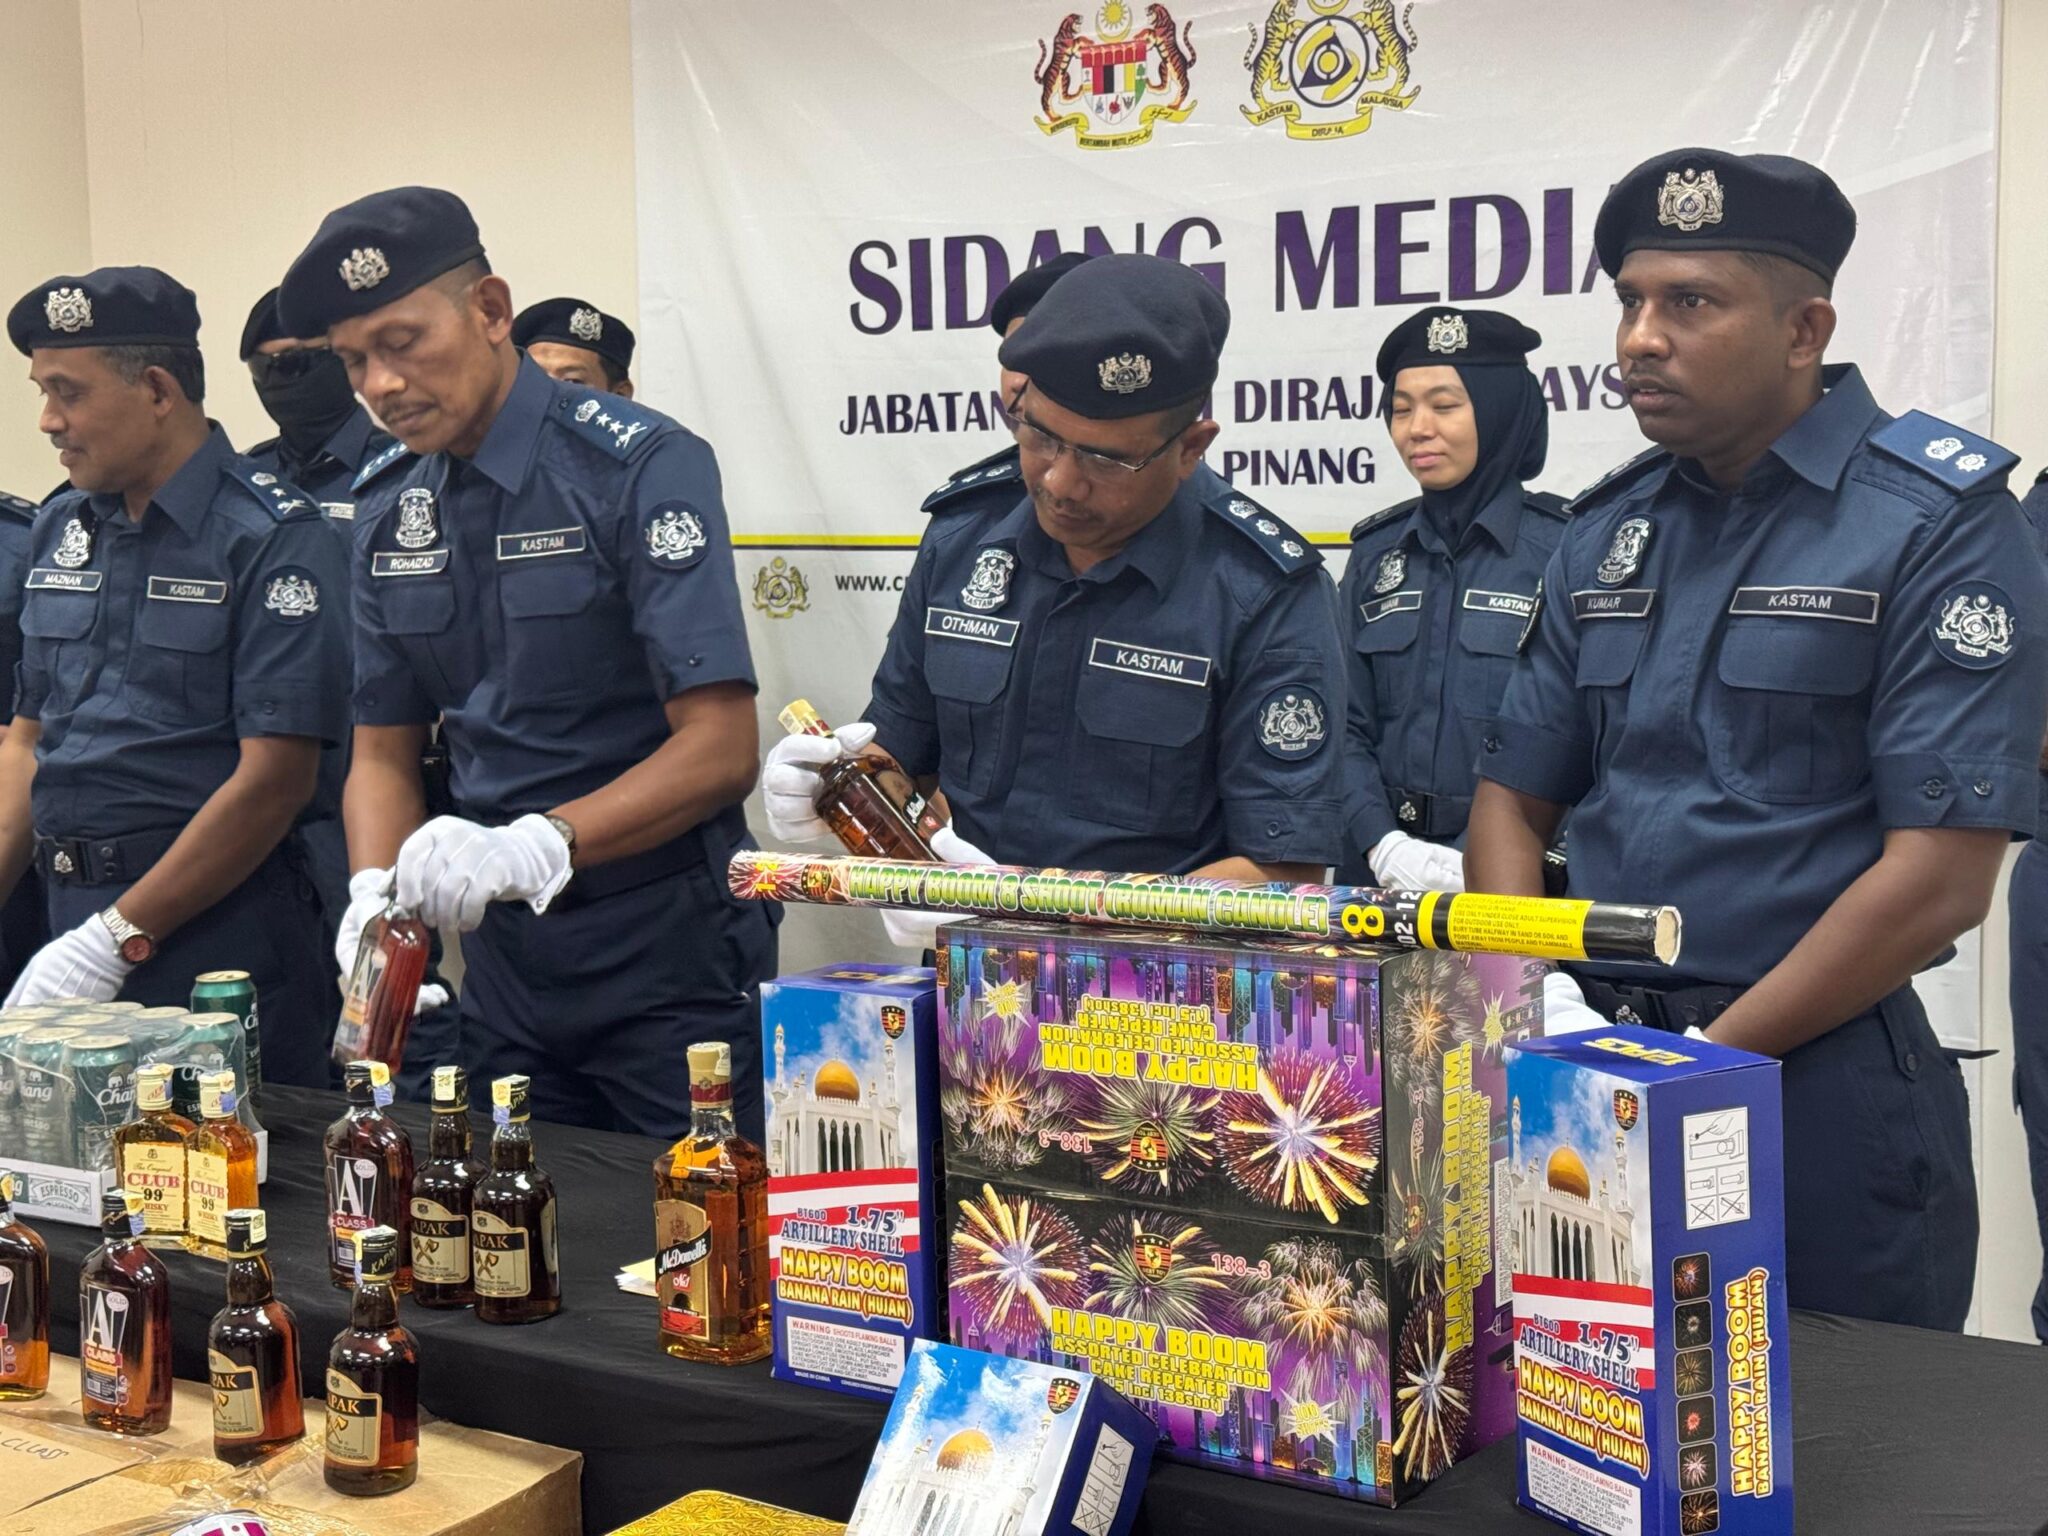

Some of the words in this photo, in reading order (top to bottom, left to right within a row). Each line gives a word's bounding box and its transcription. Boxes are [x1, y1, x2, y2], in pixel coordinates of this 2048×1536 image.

[1257, 104, 1293, 122] KASTAM
[849, 217, 1226, 336] SIDG
[1275, 184, 1618, 313] MEDI
[1233, 375, 1386, 423] DIRAJ
[1223, 446, 1376, 487] PINANG
[521, 536, 566, 551] KASTAM
[44, 573, 83, 586] MAZNAN
[169, 584, 206, 598] KASTAM
[1586, 597, 1621, 610] KUMAR
[1768, 594, 1832, 610] KASTAM
[941, 615, 999, 638] OTHMAN
[1115, 649, 1184, 676] KASTAM
[850, 864, 928, 904] HAPPY
[925, 867, 1000, 910] BOOM
[999, 874, 1021, 912] 8
[1040, 1023, 1156, 1050] CELEBRATION
[1077, 1012, 1163, 1036] REPEATER
[1169, 1021, 1216, 1041] CAKE
[1044, 1043, 1136, 1078] BOOM
[1160, 1035, 1257, 1062] ASSORTED
[1145, 1053, 1259, 1091] HAPPY
[1443, 1049, 1462, 1187] BOOM
[1038, 1129, 1093, 1153] 138-3
[40, 1184, 80, 1205] ESPRESSO
[127, 1173, 181, 1188] CLUB
[190, 1179, 225, 1199] CLUB
[144, 1203, 169, 1212] HISKY
[659, 1238, 708, 1274] McDowell's
[781, 1219, 858, 1247] ARTILLERY
[859, 1231, 905, 1257] SHELL
[781, 1247, 844, 1284] HAPPY
[847, 1256, 907, 1295] BOOM
[1211, 1253, 1272, 1280] 138-3
[1444, 1197, 1463, 1354] HAPPY
[778, 1279, 830, 1307] BANANA
[831, 1286, 862, 1312] RAIN
[862, 1291, 914, 1327] (HUJAN)
[1750, 1267, 1771, 1352] (HUJAN)
[792, 1320, 830, 1333] WARNING
[879, 1336, 896, 1346] BALLS
[1051, 1307, 1159, 1350] HAPPY
[1166, 1327, 1268, 1371] BOOM
[1726, 1277, 1750, 1386] BOOM
[1053, 1336, 1143, 1366] ASSORTED
[1148, 1353, 1270, 1389] CELEBRATION
[1519, 1324, 1591, 1372] ARTILLERY
[1592, 1356, 1640, 1393] SHELL
[1091, 1358, 1136, 1380] CAKE
[1140, 1366, 1229, 1399] REPEATER
[1519, 1356, 1577, 1411] HAPPY
[1579, 1383, 1644, 1439] BOOM
[1752, 1355, 1768, 1406] RAIN
[1518, 1393, 1565, 1435] BANANA
[1566, 1414, 1595, 1448] RAIN
[1596, 1422, 1649, 1479] (HUJAN)
[1731, 1387, 1753, 1495] HAPPY
[1753, 1407, 1771, 1497] BANANA
[1530, 1443, 1565, 1468] WARNING
[1614, 1482, 1632, 1498] BALLS
